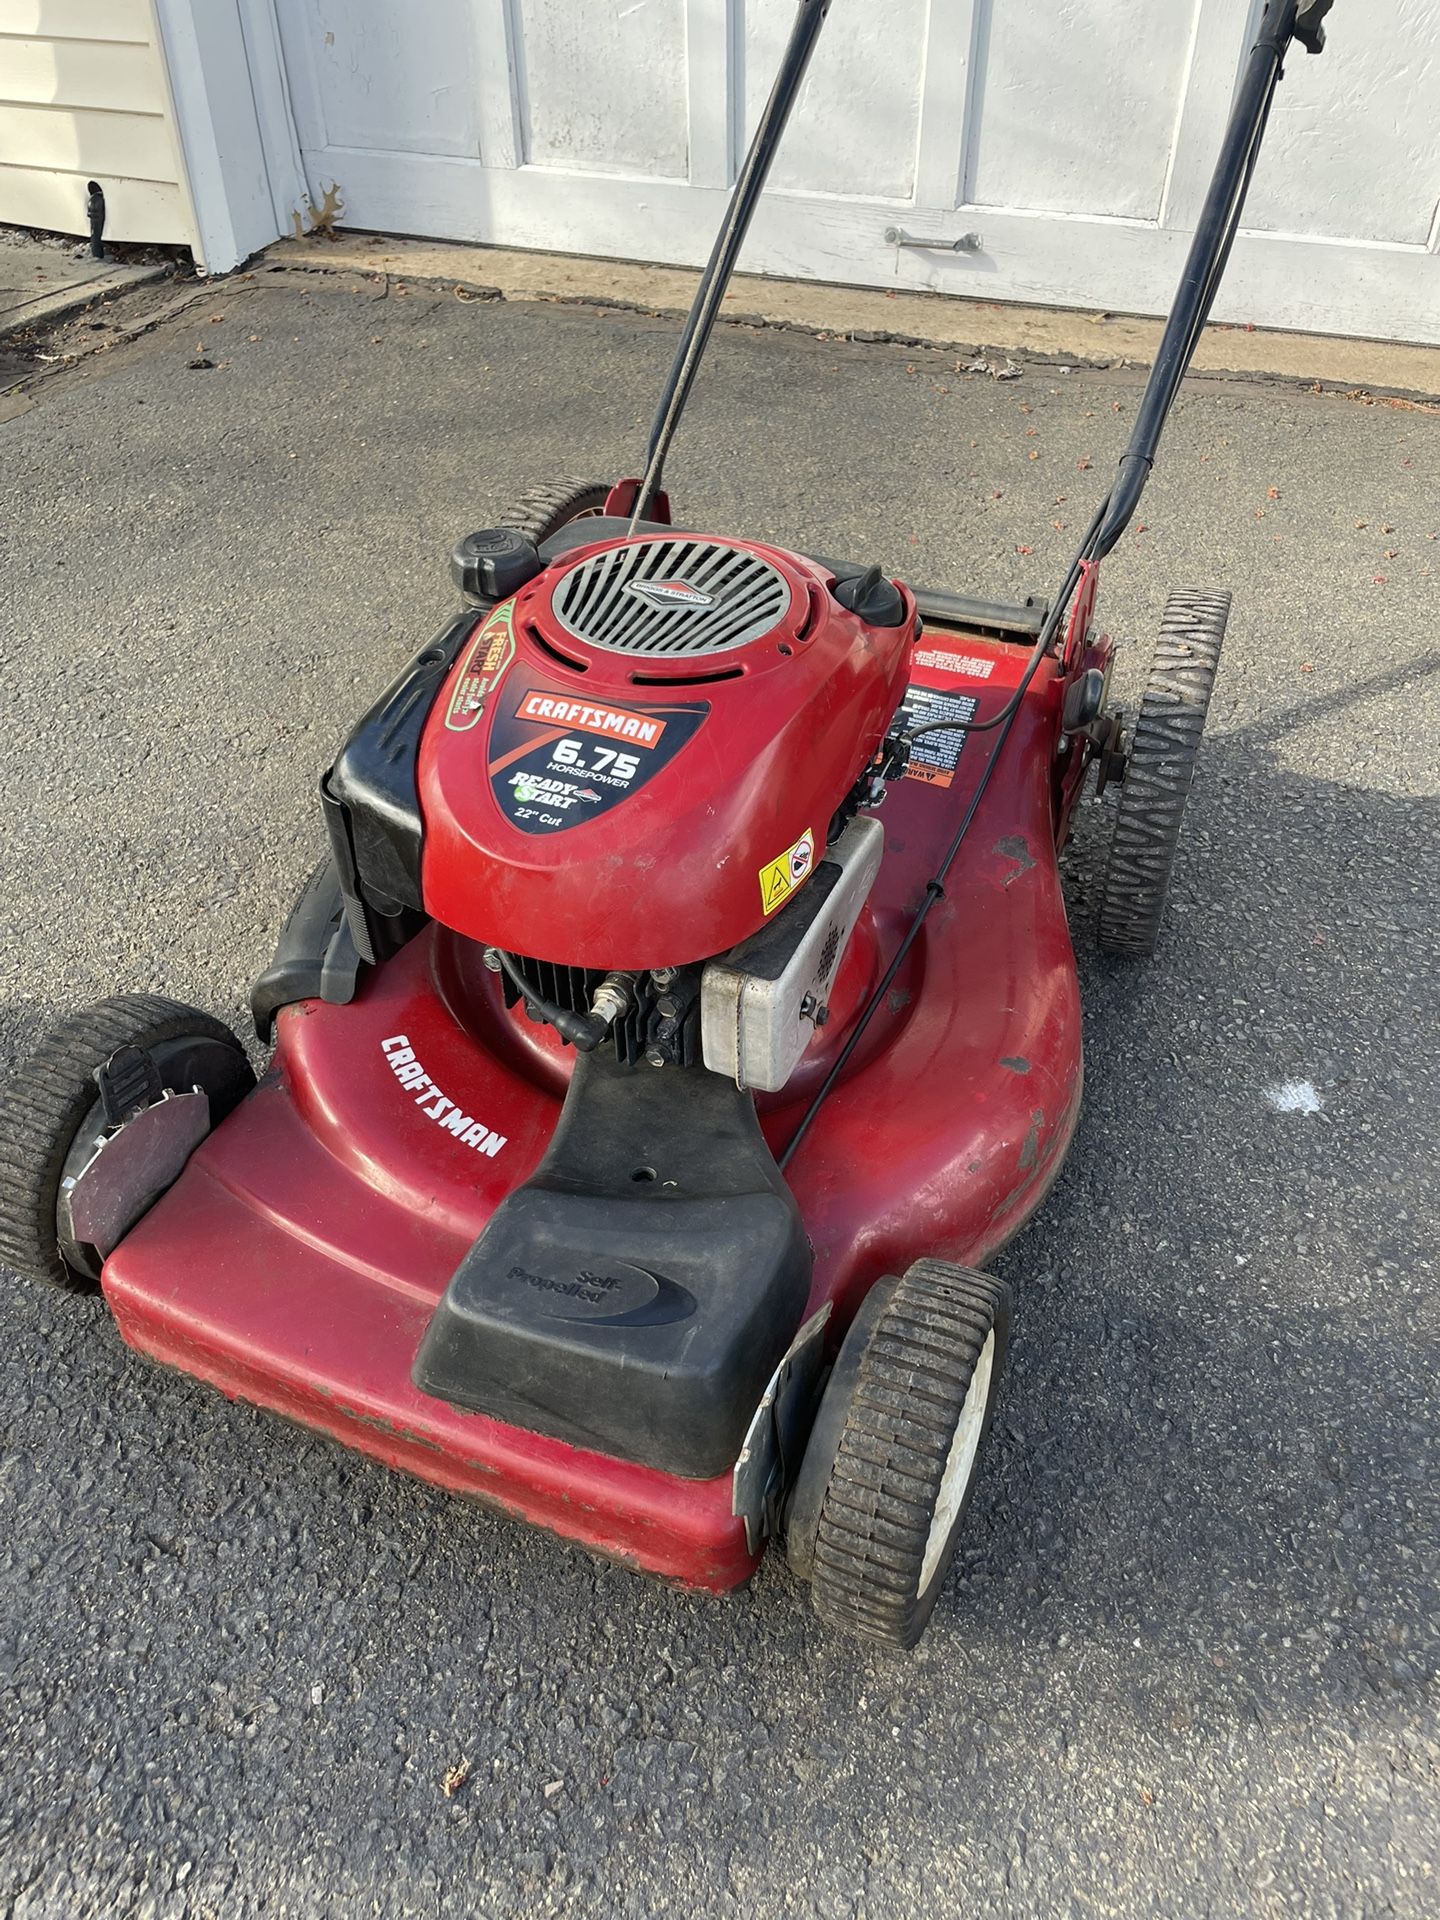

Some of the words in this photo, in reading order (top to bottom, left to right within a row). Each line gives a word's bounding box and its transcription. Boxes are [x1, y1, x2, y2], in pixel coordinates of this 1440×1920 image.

[670, 590, 707, 602] STRATTON
[470, 638, 494, 676] START
[482, 632, 508, 670] FRESH
[525, 698, 658, 742] CRAFTSMAN
[546, 762, 630, 789] HORSEPOWER
[552, 739, 640, 780] 6.75
[508, 772, 578, 795] READY
[519, 786, 578, 809] START
[514, 808, 539, 818] 22"
[539, 814, 562, 826] Cut
[381, 1034, 508, 1158] CRAFTSMAN
[506, 1266, 608, 1303] Propelled
[576, 1270, 624, 1292] Self-
